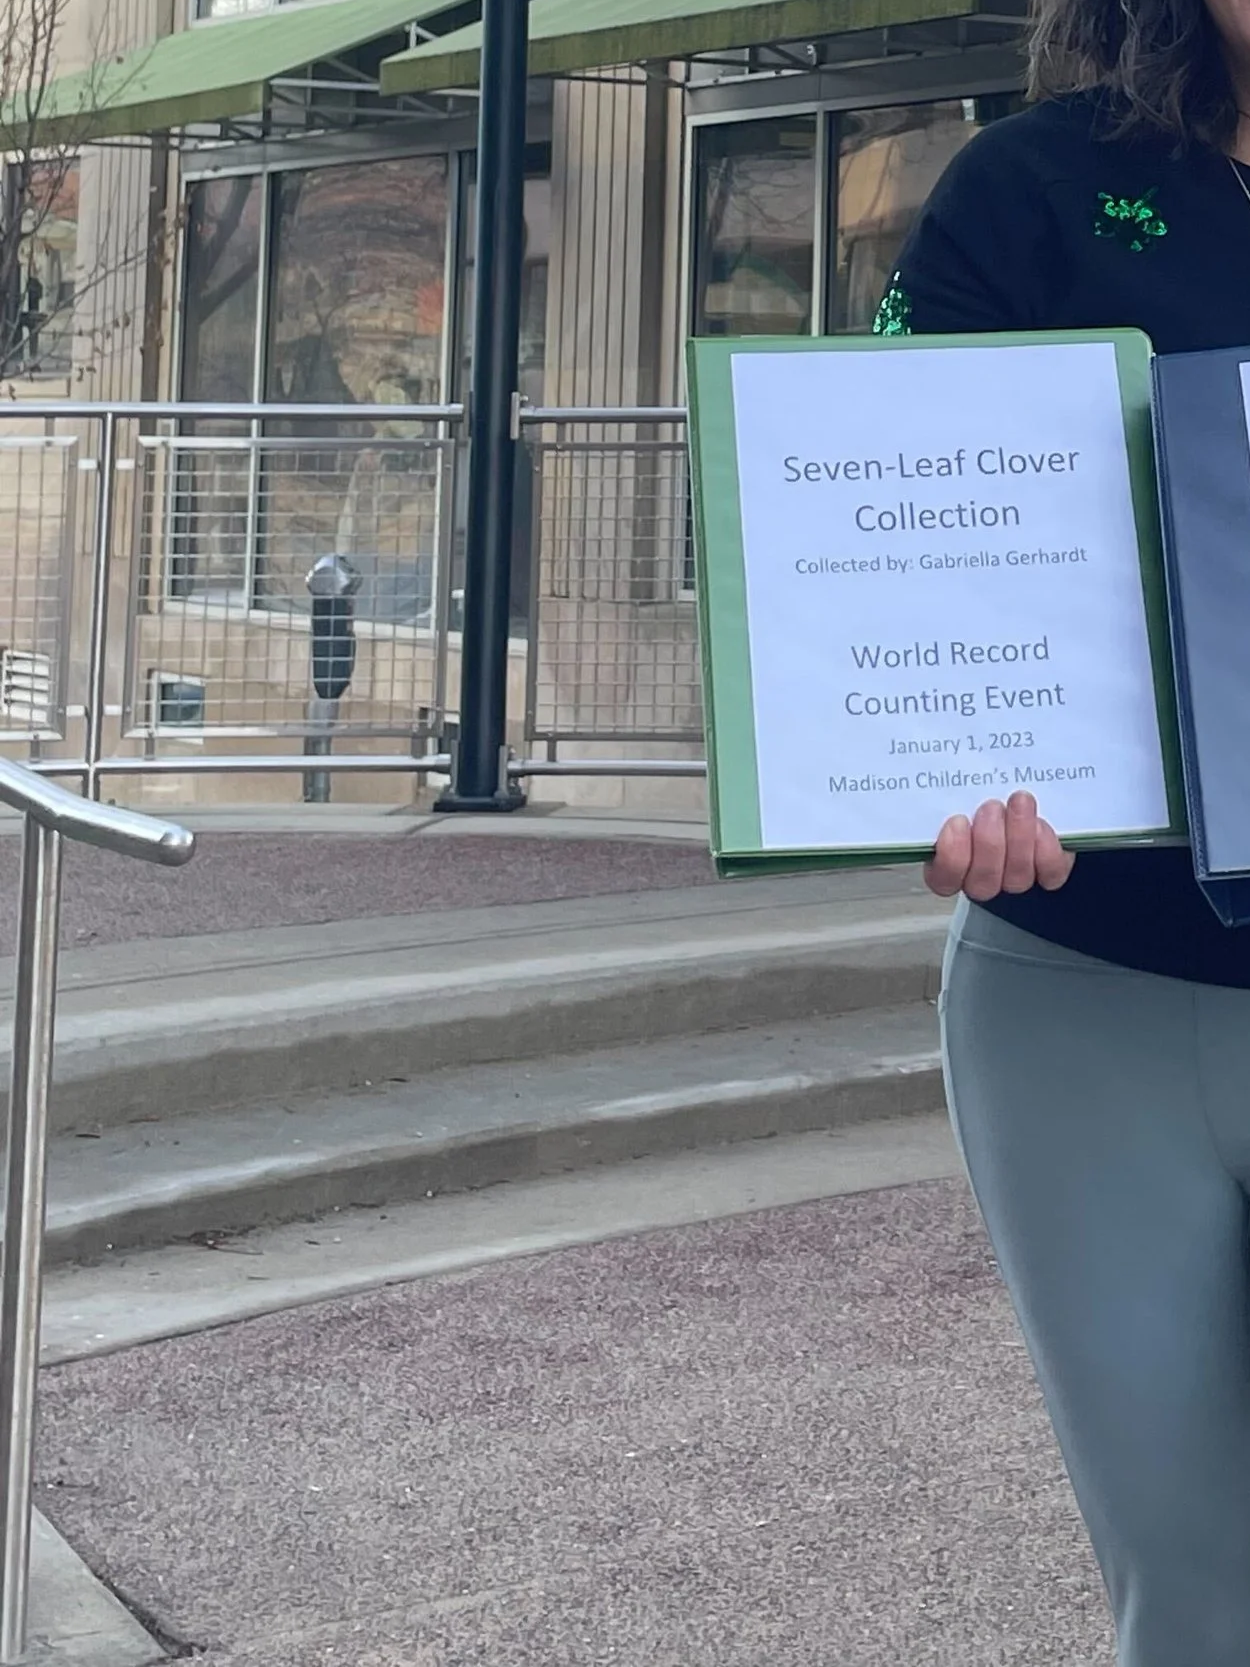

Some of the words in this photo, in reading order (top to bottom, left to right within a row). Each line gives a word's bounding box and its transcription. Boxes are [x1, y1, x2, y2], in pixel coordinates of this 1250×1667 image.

[783, 448, 965, 482] Seven-Leaf
[977, 446, 1080, 475] Clover
[855, 501, 1020, 531] Collection
[795, 556, 881, 575] Collected
[886, 555, 913, 573] by:
[919, 551, 1001, 570] Gabriella
[1005, 546, 1087, 566] Gerhardt
[851, 641, 940, 669] World
[950, 636, 1049, 665] Record
[845, 689, 977, 718] Counting
[986, 684, 1066, 710] Event
[888, 737, 961, 756] January
[966, 735, 983, 753] 1,
[989, 732, 1035, 750] 2023
[829, 774, 909, 793] Madison
[915, 768, 1009, 789] Children's
[1014, 764, 1096, 783] Museum
